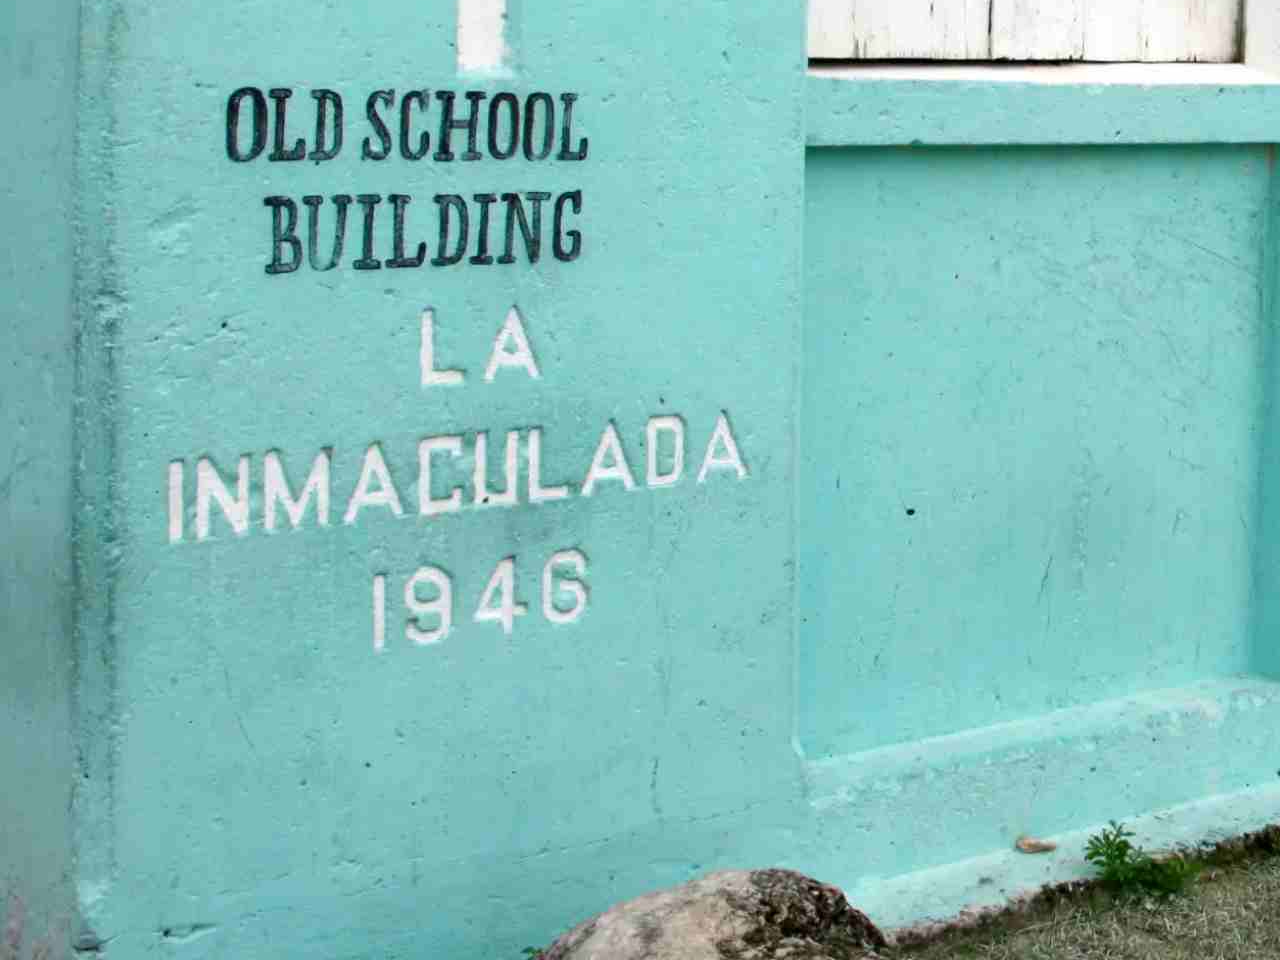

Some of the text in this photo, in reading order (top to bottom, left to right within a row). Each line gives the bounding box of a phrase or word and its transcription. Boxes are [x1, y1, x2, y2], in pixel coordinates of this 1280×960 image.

[225, 86, 589, 162] OLD SCHOOL
[264, 190, 583, 275] BUILDING
[419, 304, 541, 386] LA
[167, 409, 749, 544] INMACULADA
[371, 548, 591, 653] 1946
